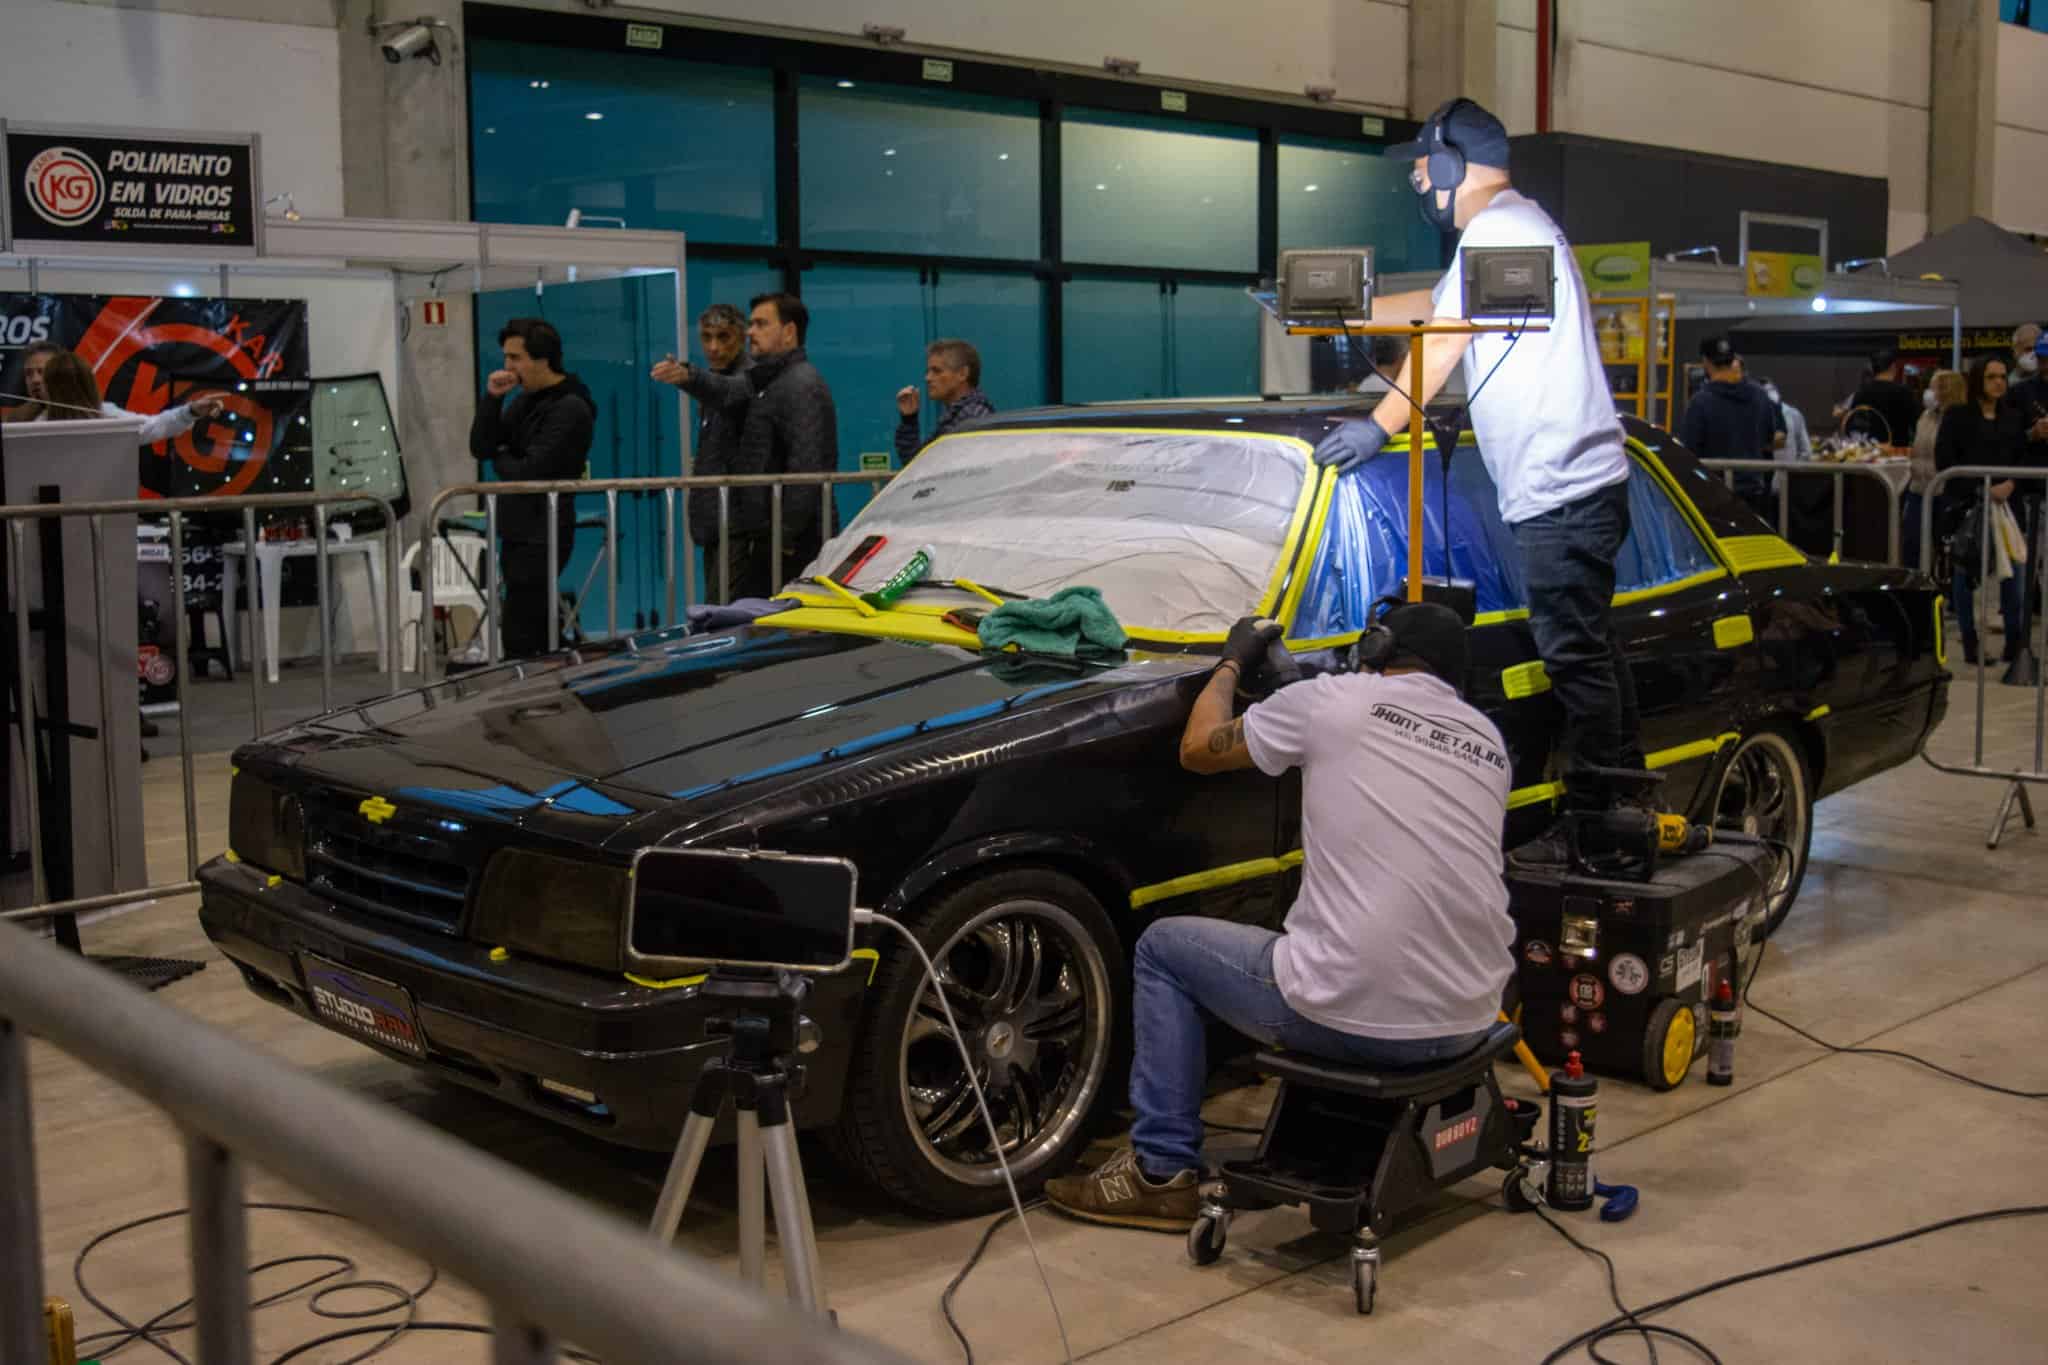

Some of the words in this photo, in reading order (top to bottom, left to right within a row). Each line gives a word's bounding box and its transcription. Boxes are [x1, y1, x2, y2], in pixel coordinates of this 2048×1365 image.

[107, 149, 233, 177] POLIMENTO
[109, 181, 146, 204] EM
[154, 183, 233, 207] VIDROS
[113, 207, 147, 219] SOLDA
[149, 208, 163, 219] DE
[1429, 729, 1505, 770] DETAILING
